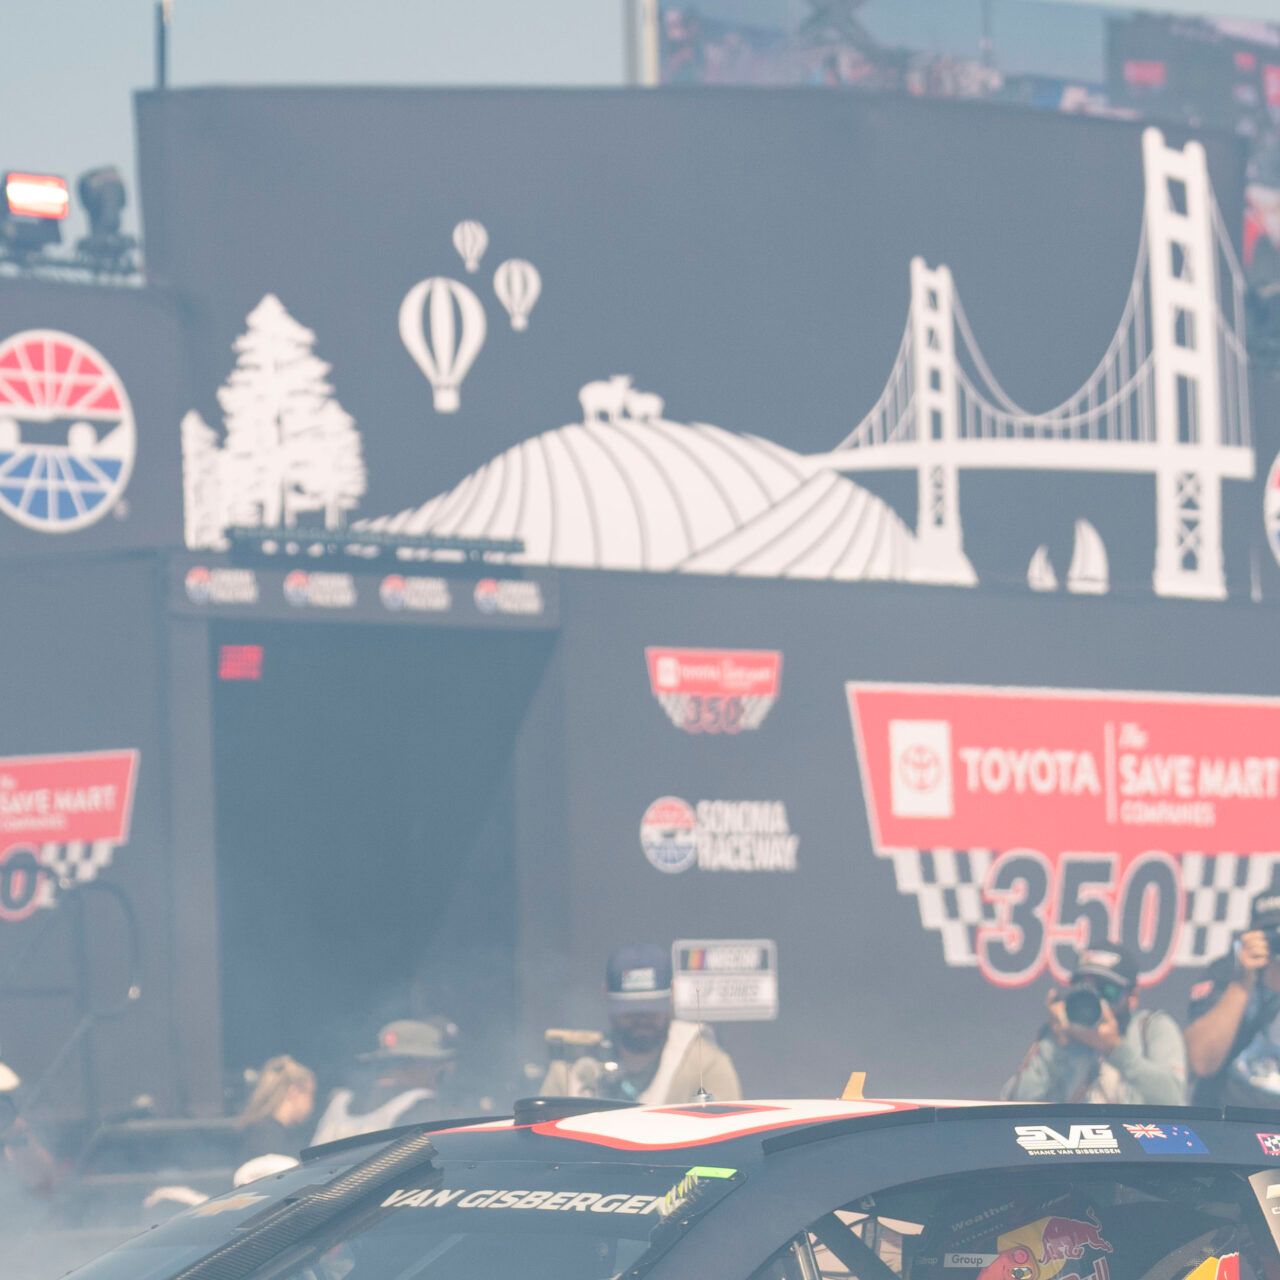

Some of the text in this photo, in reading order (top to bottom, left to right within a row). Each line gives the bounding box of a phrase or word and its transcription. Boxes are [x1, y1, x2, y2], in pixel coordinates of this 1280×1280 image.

[959, 748, 1101, 795] TOYOTA
[1120, 756, 1193, 798] SAVE
[976, 848, 1187, 988] 350
[1014, 1125, 1118, 1149] SVG
[380, 1188, 466, 1208] VAN
[951, 1254, 984, 1269] Group
